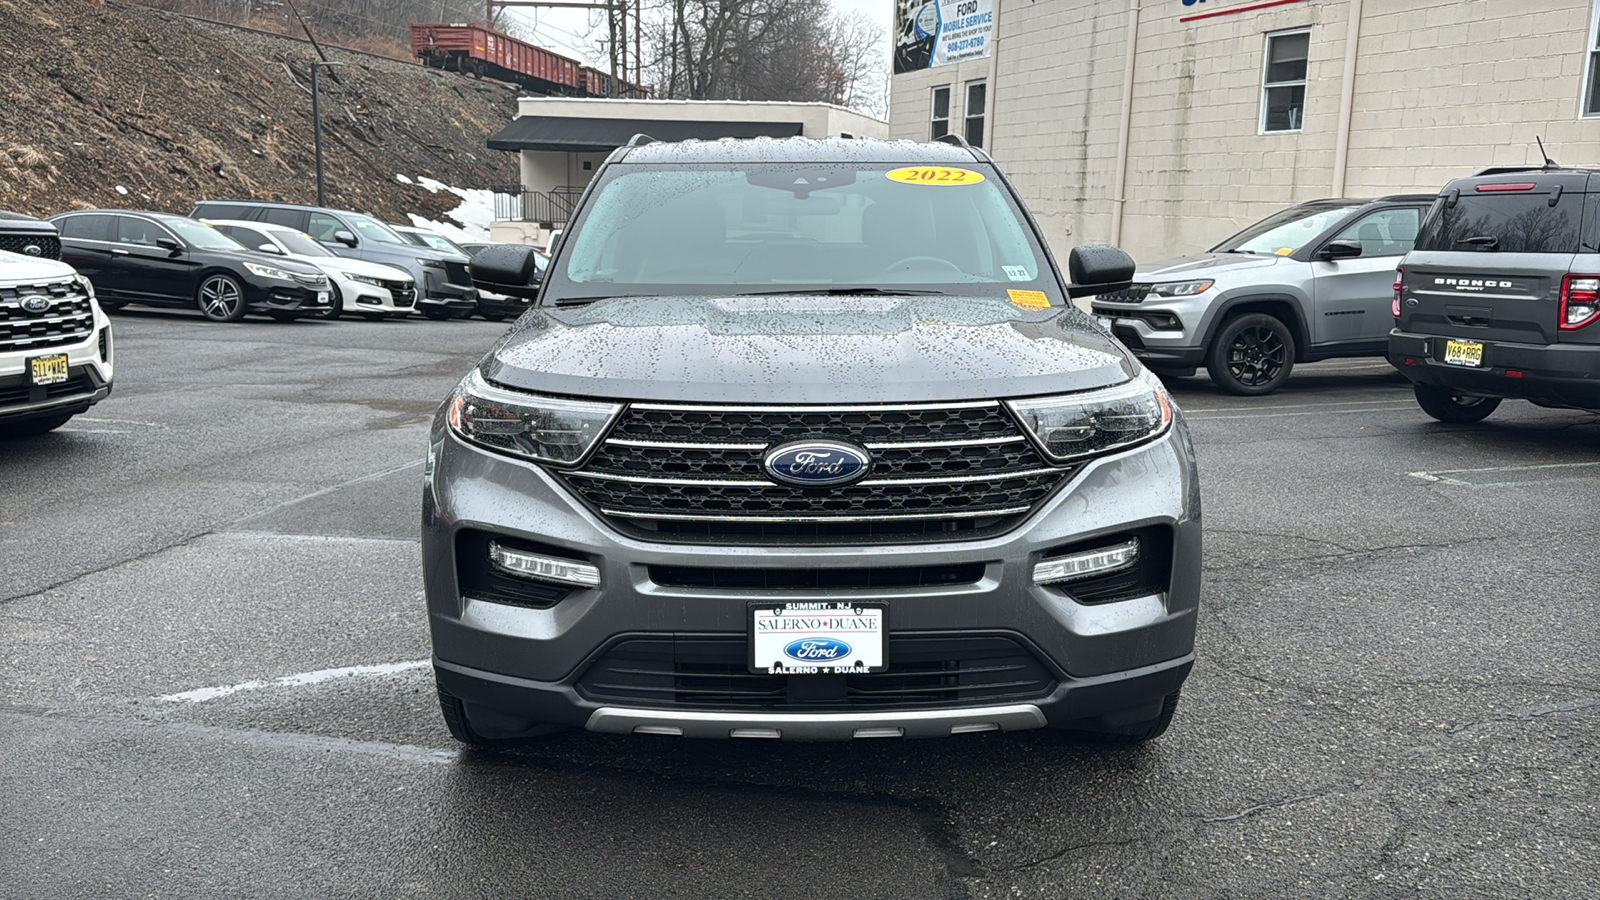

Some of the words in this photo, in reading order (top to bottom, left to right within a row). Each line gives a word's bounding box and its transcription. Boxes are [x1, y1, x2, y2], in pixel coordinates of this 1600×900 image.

[957, 0, 978, 17] FORD
[943, 18, 965, 33] MOBILE
[965, 11, 992, 27] SERVICE
[968, 28, 977, 36] SHOP
[904, 170, 966, 181] 2022
[1434, 278, 1512, 288] BRONCO
[29, 298, 47, 309] Ford
[790, 451, 844, 475] Ford
[837, 602, 852, 610] NJ
[758, 618, 821, 631] SALERNO
[829, 618, 878, 630] DUANE
[796, 641, 838, 658] Ford
[768, 666, 818, 674] SALERNO
[834, 666, 870, 674] DUANE
